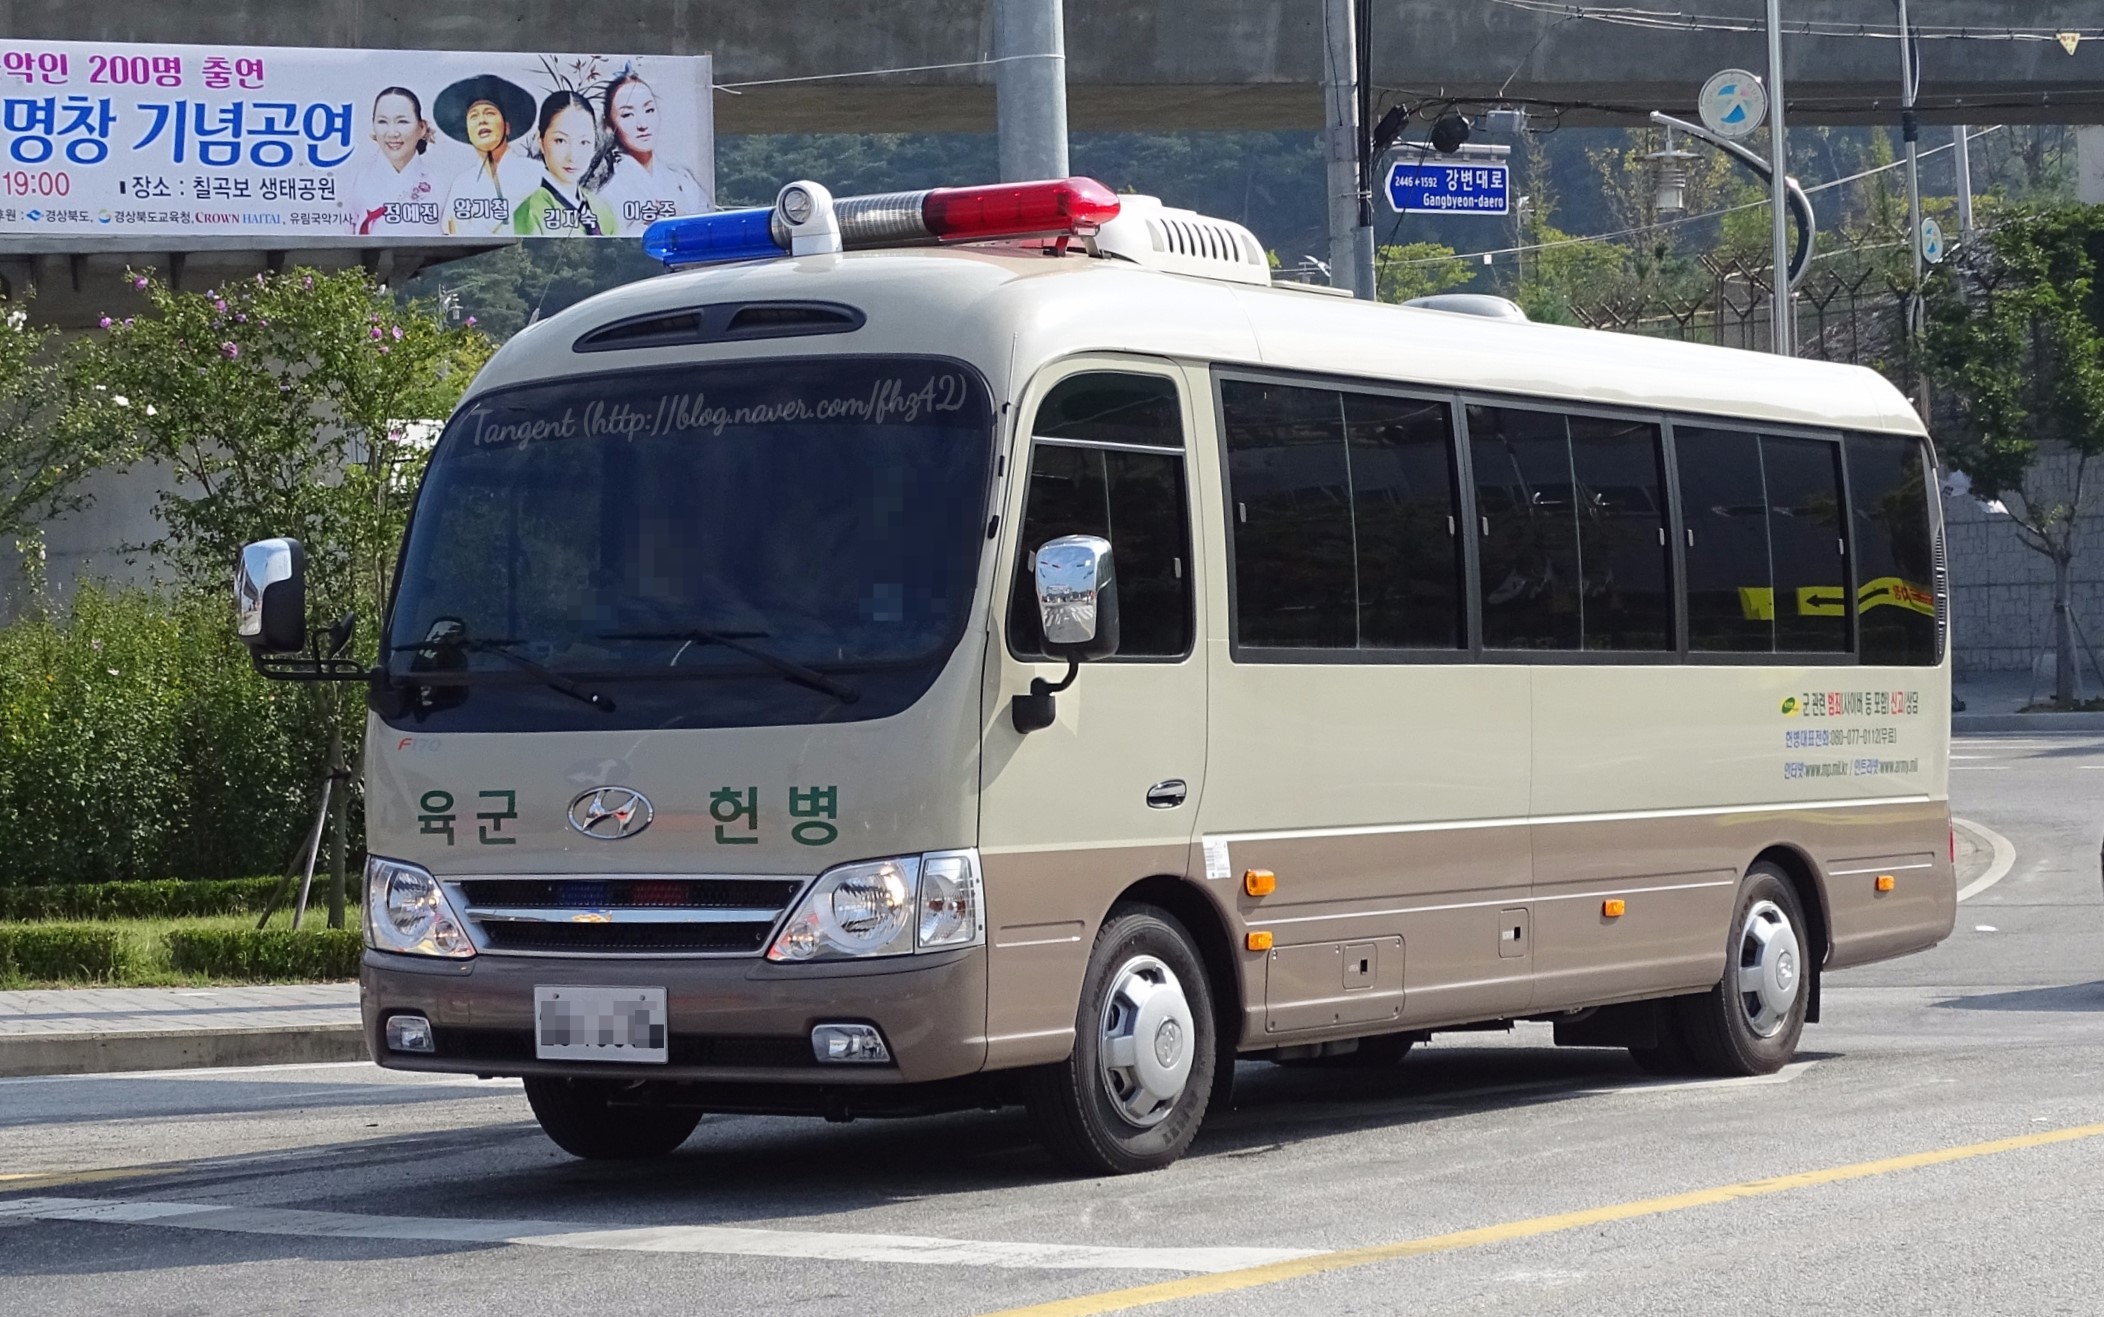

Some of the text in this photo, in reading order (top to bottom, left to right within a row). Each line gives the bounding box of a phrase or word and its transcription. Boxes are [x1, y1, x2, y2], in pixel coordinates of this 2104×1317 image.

[88, 55, 182, 88] 200명
[202, 57, 265, 90] 출연
[4, 96, 355, 167] 명창 기념공연
[2, 171, 70, 196] 19:00
[132, 175, 171, 199] 장소
[193, 177, 251, 200] 칠곡보
[259, 178, 336, 201] 생태공원
[1395, 169, 1503, 191] 2446 1592 강변대로
[384, 202, 439, 224] 정예진
[1423, 193, 1504, 209] Gangbyeon-daero
[195, 211, 240, 224] CROWN
[544, 208, 598, 230] 김지숙
[1803, 693, 1810, 716] 군
[1812, 693, 1826, 716] 관련
[1865, 692, 1872, 716] 등
[418, 790, 518, 846] 육군
[709, 785, 838, 846] 헌병
